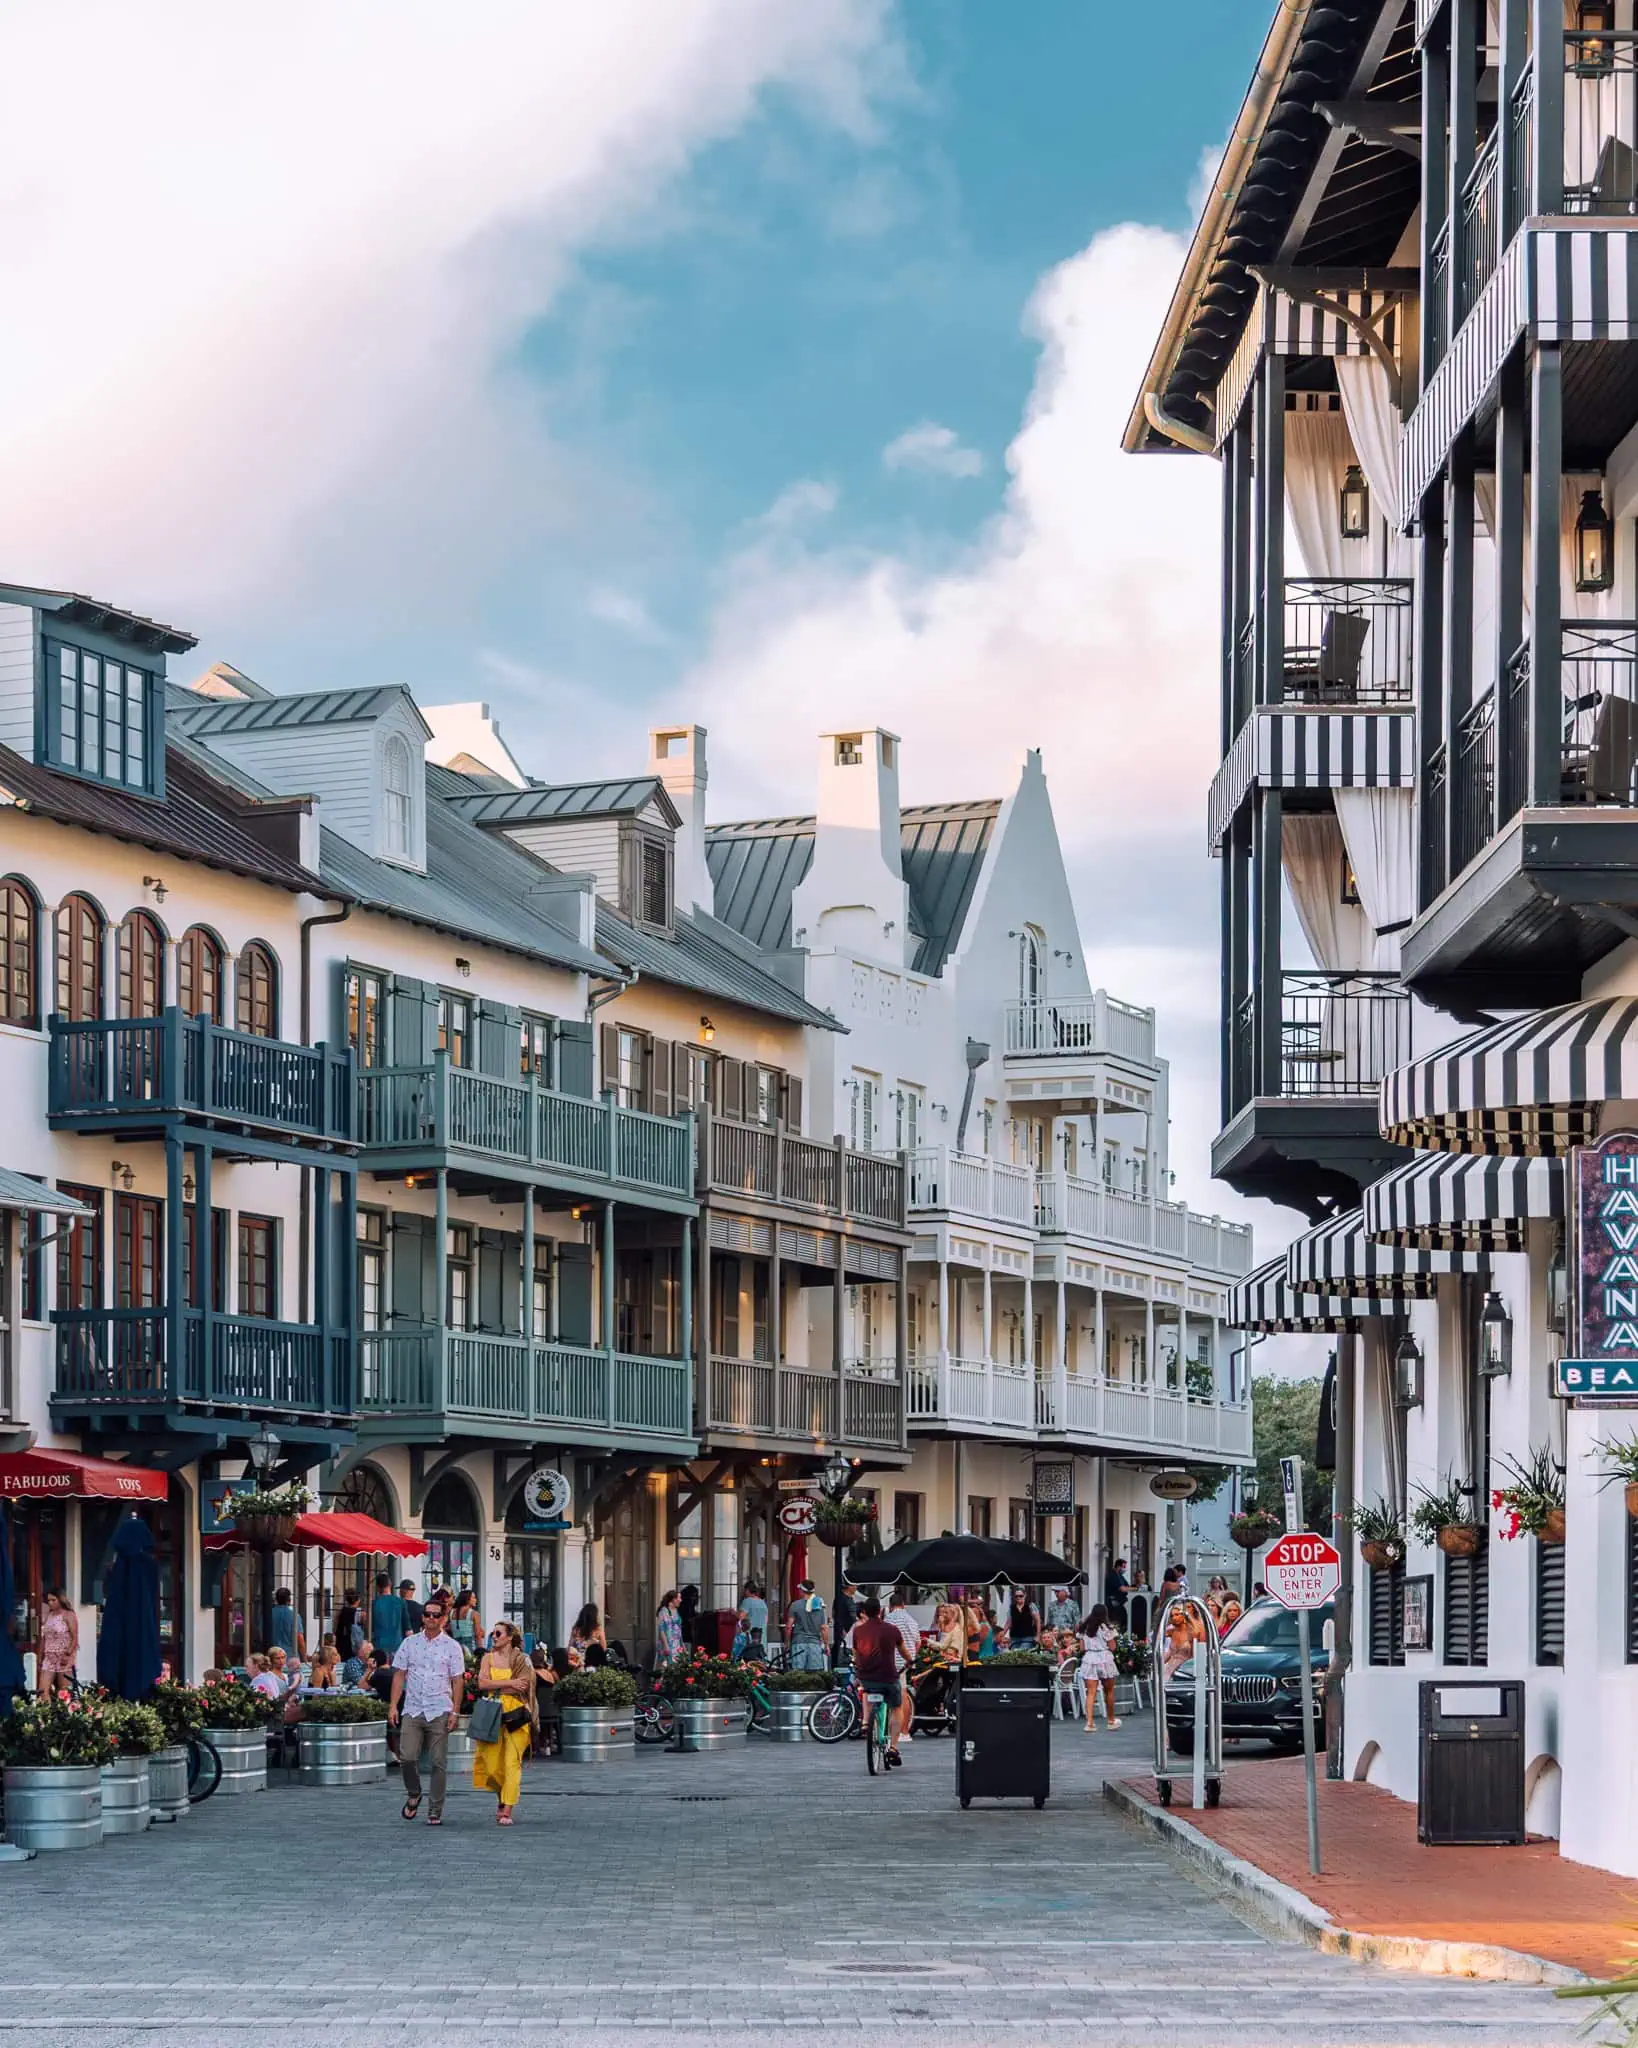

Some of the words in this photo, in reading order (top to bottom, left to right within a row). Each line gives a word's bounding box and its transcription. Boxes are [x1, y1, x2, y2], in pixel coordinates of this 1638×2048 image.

[1602, 1157, 1638, 1348] HAVANA
[1567, 1368, 1634, 1385] BEA
[3, 1475, 71, 1490] FABULOUS
[116, 1478, 142, 1491] TOYS
[1024, 1483, 1034, 1497] 3
[782, 1507, 817, 1525] CK
[489, 1545, 501, 1561] 58
[1279, 1543, 1325, 1563] STOP
[1280, 1568, 1296, 1578] DO
[1302, 1566, 1325, 1577] NOT
[1284, 1579, 1322, 1590] ENTER
[1286, 1592, 1300, 1600] ONE
[1305, 1591, 1320, 1599] WAY
